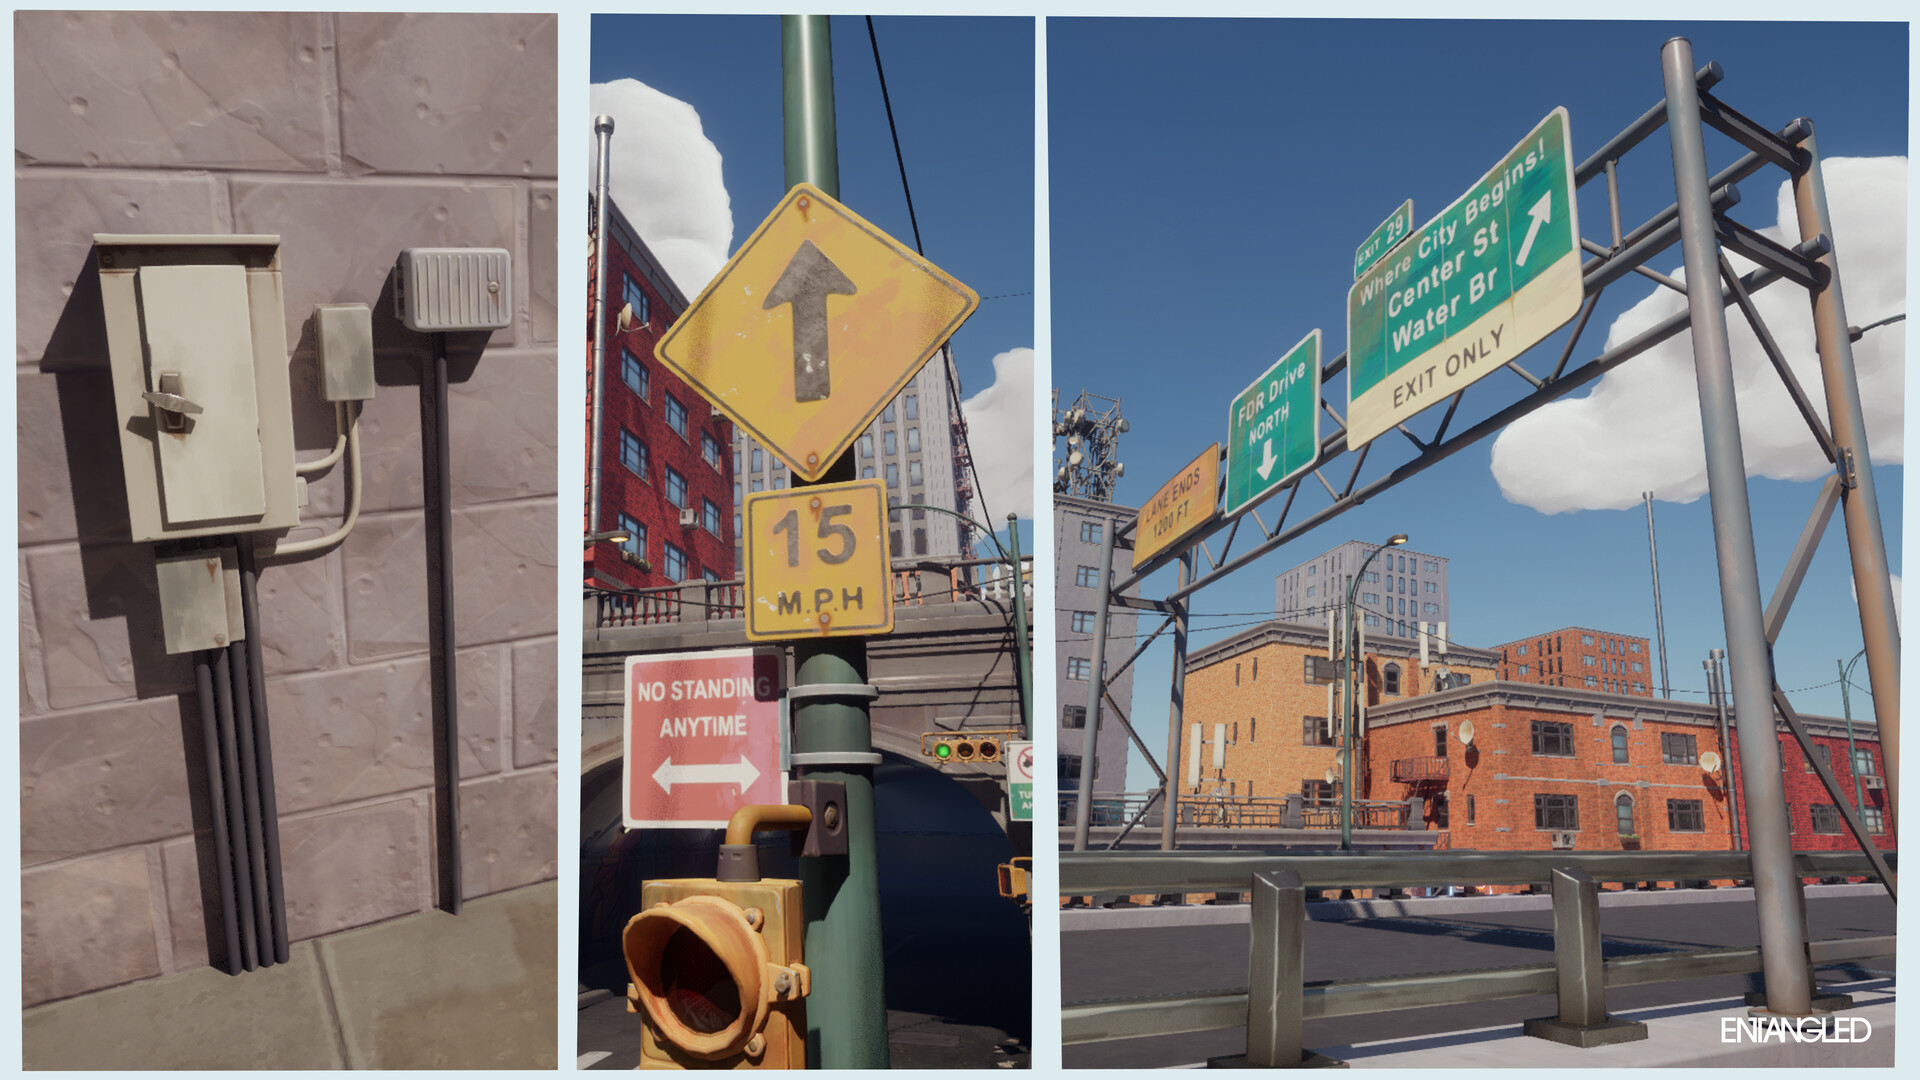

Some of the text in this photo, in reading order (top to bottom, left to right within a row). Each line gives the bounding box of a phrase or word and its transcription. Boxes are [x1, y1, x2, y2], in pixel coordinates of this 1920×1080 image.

[1358, 214, 1404, 267] EXIT 29
[1360, 137, 1544, 307] Where City Begins!
[1388, 219, 1500, 318] Center St
[1392, 267, 1498, 353] Water Br
[1238, 361, 1305, 428] FDR Drive
[1393, 323, 1504, 409] EXIT ONLY
[1249, 401, 1289, 446] NORTH
[1146, 466, 1200, 523] LANE ENDS
[1153, 499, 1190, 539] 1200 FT
[773, 504, 857, 567] 15
[777, 586, 864, 616] M.P.H
[638, 676, 771, 702] NO STANDING
[659, 715, 748, 738] ANYTIME
